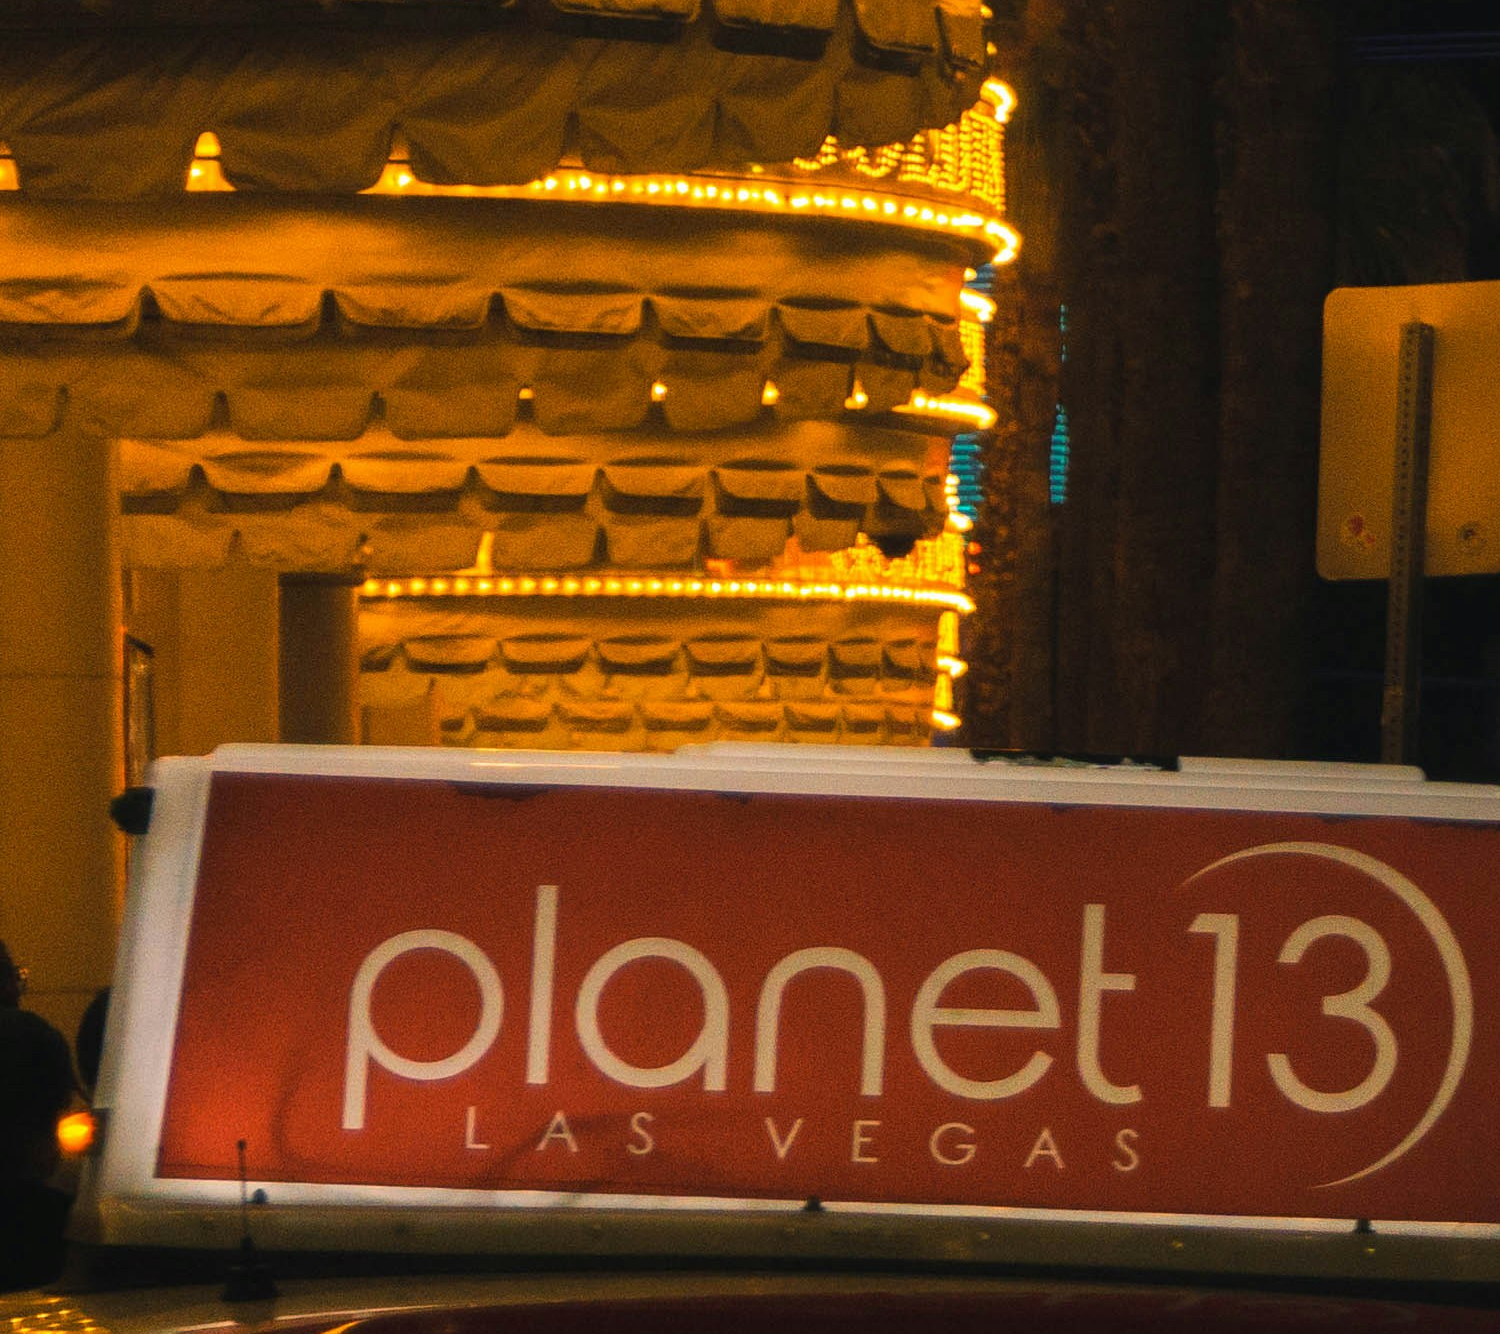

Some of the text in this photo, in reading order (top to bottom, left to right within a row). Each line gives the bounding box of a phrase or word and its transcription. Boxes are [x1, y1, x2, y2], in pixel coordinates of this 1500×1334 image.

[342, 884, 1401, 1130] planet 13
[465, 1105, 1142, 1174] LAS VEGAS
